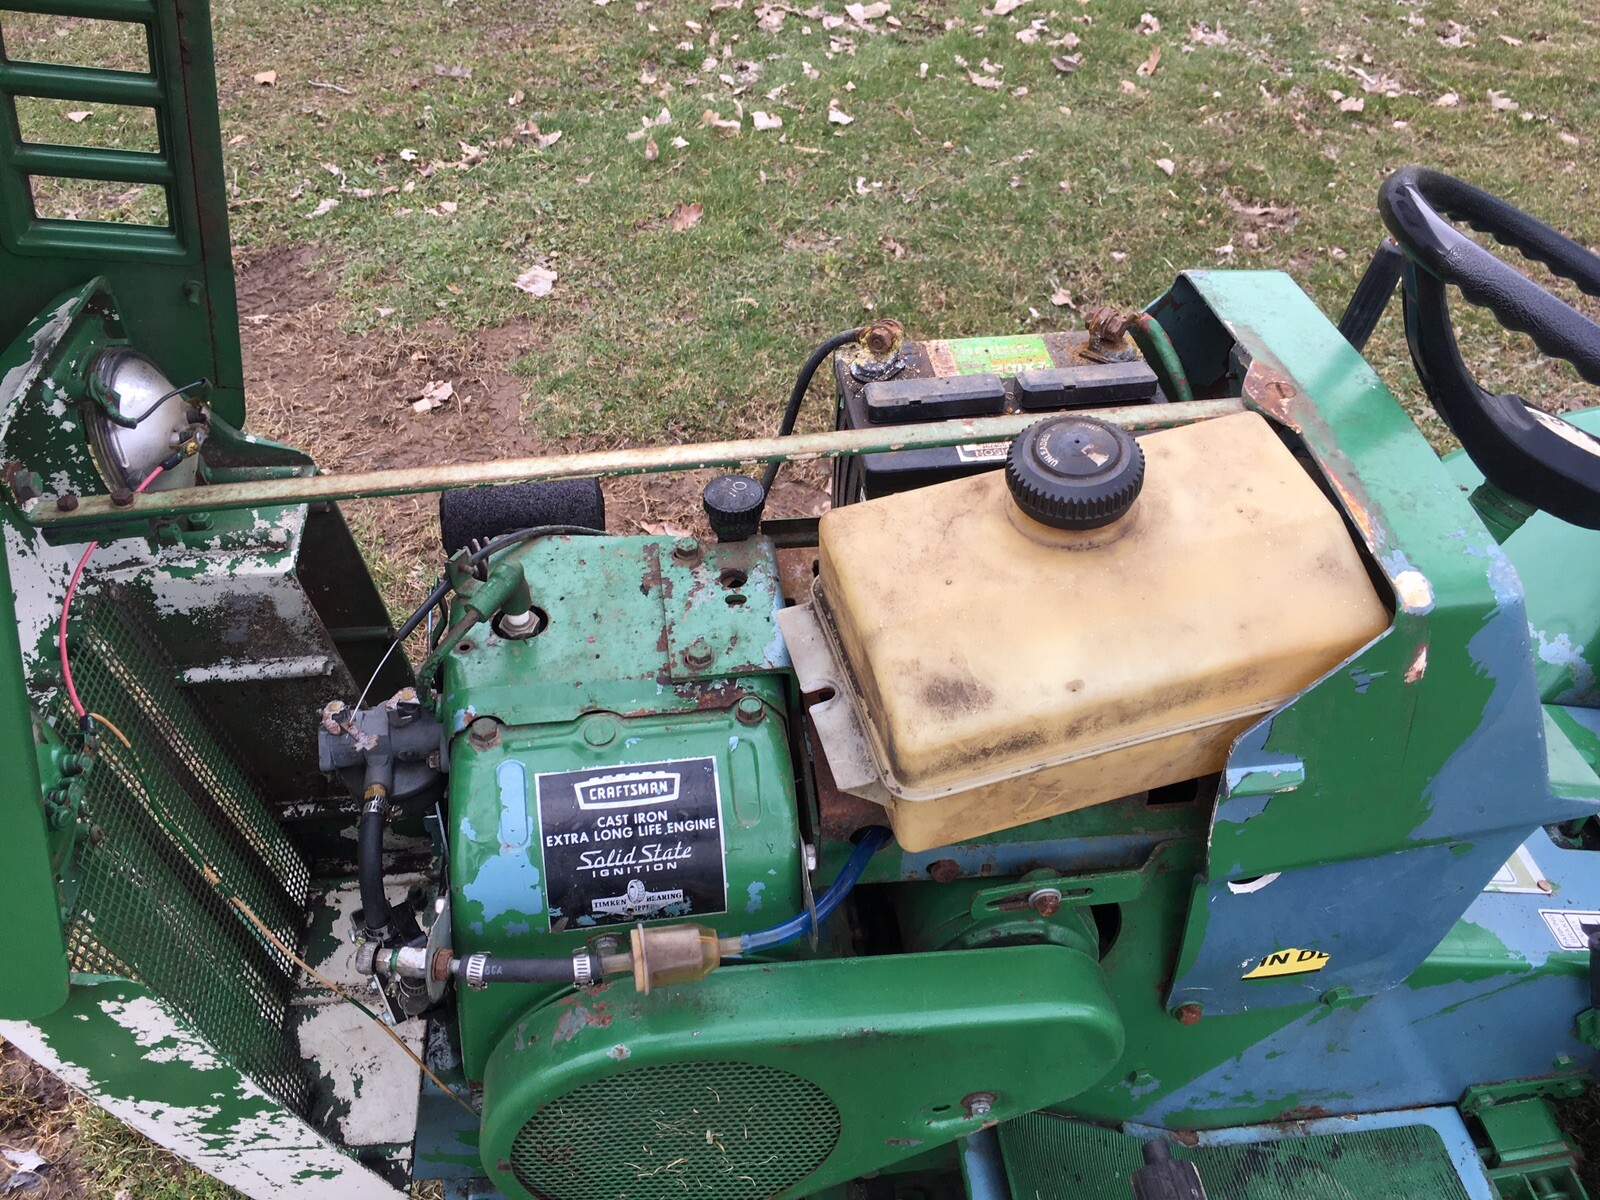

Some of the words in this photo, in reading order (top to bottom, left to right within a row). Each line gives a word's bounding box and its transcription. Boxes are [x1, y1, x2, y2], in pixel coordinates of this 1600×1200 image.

[1039, 433, 1059, 467] UNLEADED
[589, 781, 668, 800] CRAFTSMAN
[597, 814, 628, 828] CAST
[634, 810, 668, 824] IRON
[546, 833, 589, 847] EXTRA
[594, 826, 633, 842] LONG
[638, 823, 662, 837] LIFE
[667, 818, 716, 834] ENGINE
[576, 846, 636, 871] Solid
[638, 841, 692, 864] State
[592, 862, 678, 878] IGNITION
[593, 899, 627, 909] TIMKEN
[646, 892, 682, 903] BEARING
